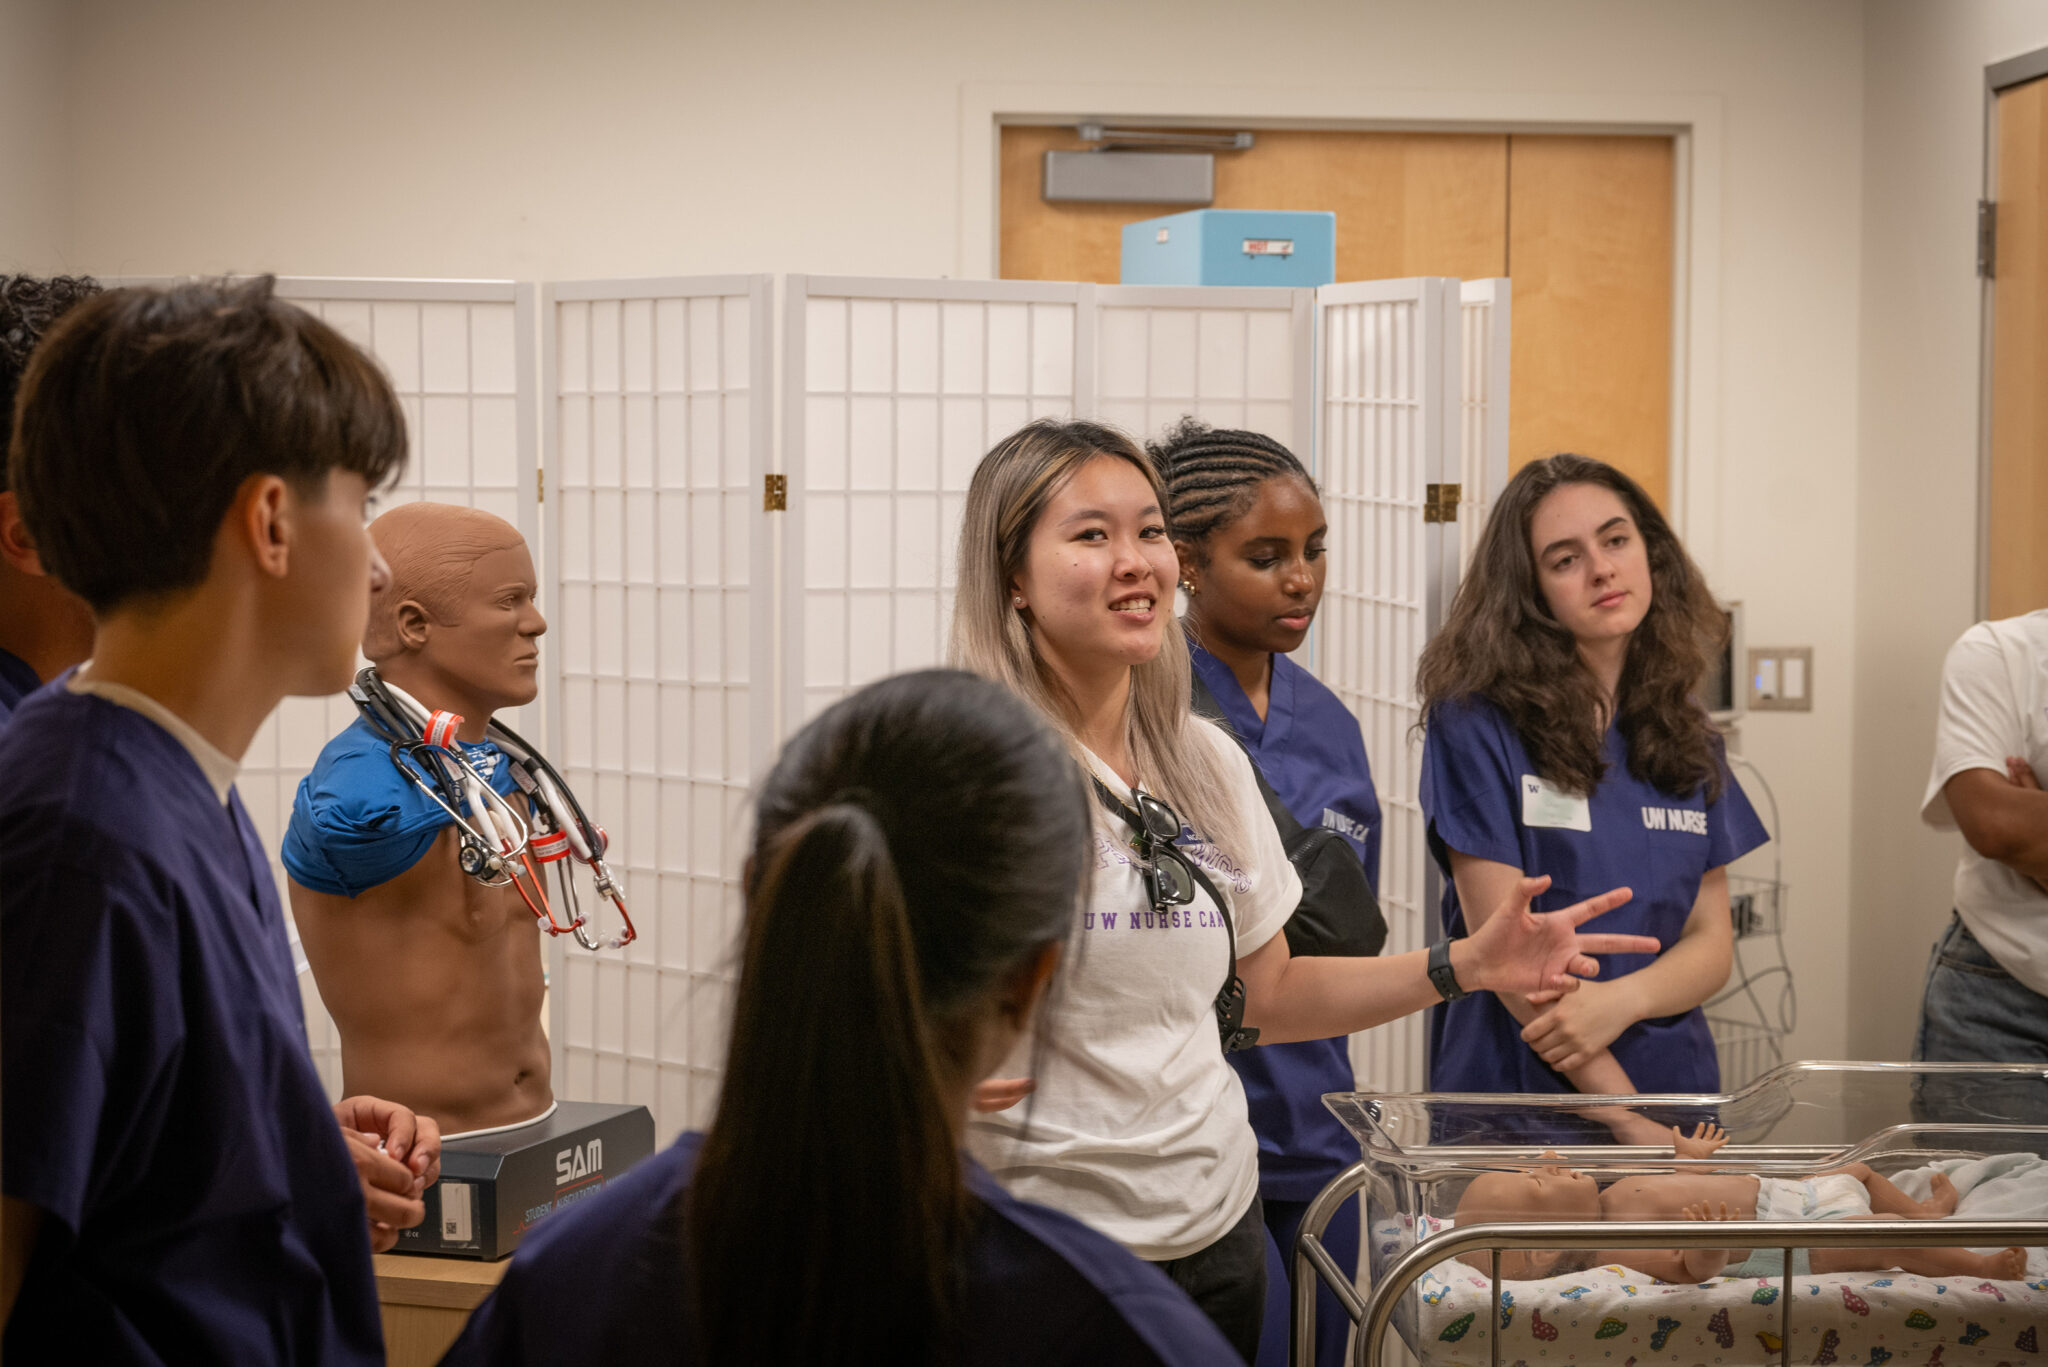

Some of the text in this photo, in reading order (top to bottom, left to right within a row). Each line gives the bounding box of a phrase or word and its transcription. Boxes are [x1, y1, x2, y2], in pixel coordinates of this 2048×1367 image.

[1641, 806, 1708, 835] UW NURSE
[1084, 912, 1118, 931] UW
[1129, 911, 1193, 930] NURSE
[556, 1138, 603, 1186] SAM
